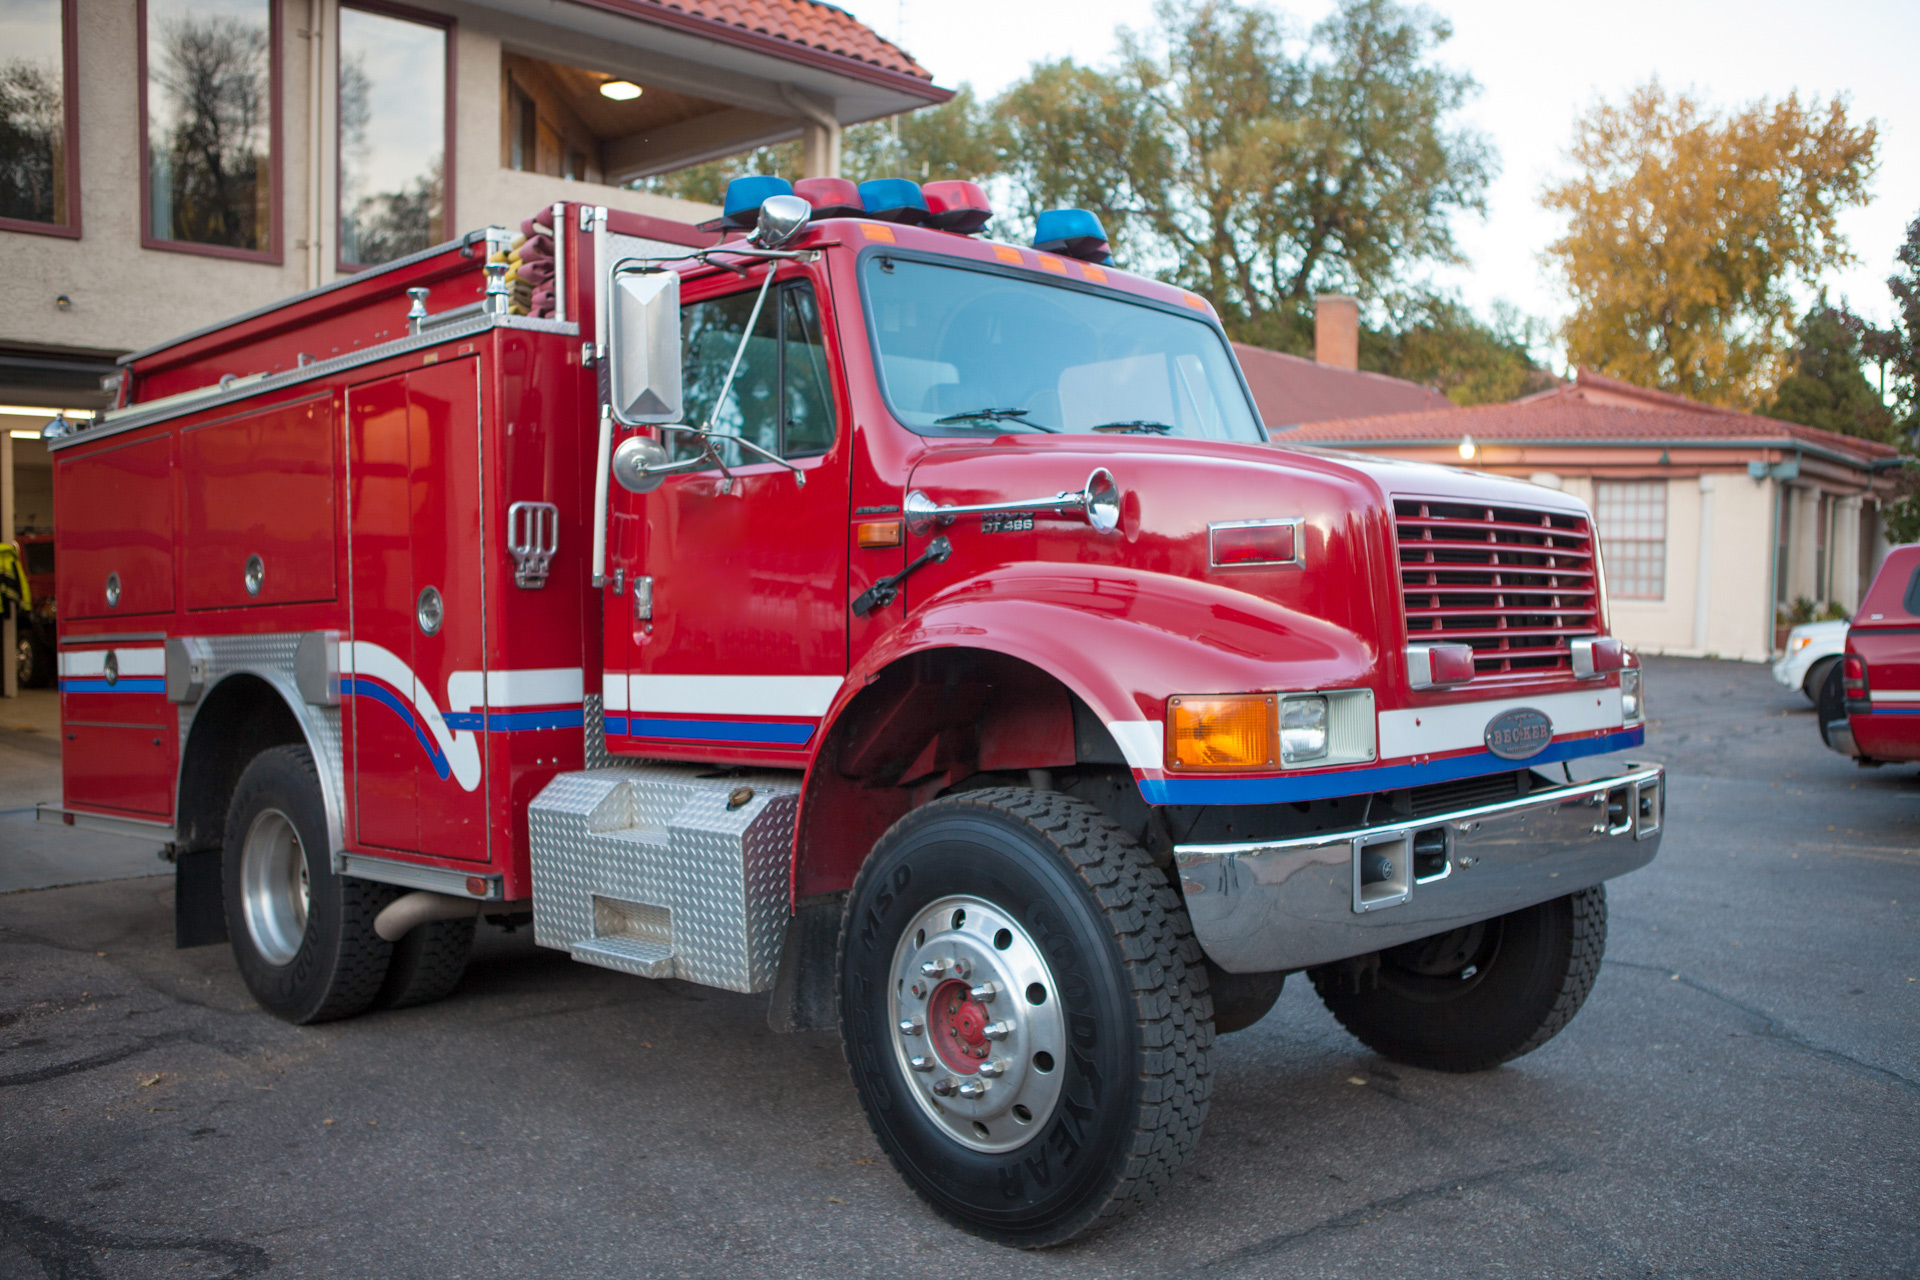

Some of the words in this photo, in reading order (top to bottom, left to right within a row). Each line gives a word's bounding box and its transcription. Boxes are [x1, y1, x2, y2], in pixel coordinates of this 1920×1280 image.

[982, 521, 1001, 534] DT
[1003, 518, 1034, 532] 466
[1493, 724, 1549, 745] BECKER
[861, 864, 913, 951] MSD
[997, 898, 1103, 1201] GOODYEAR
